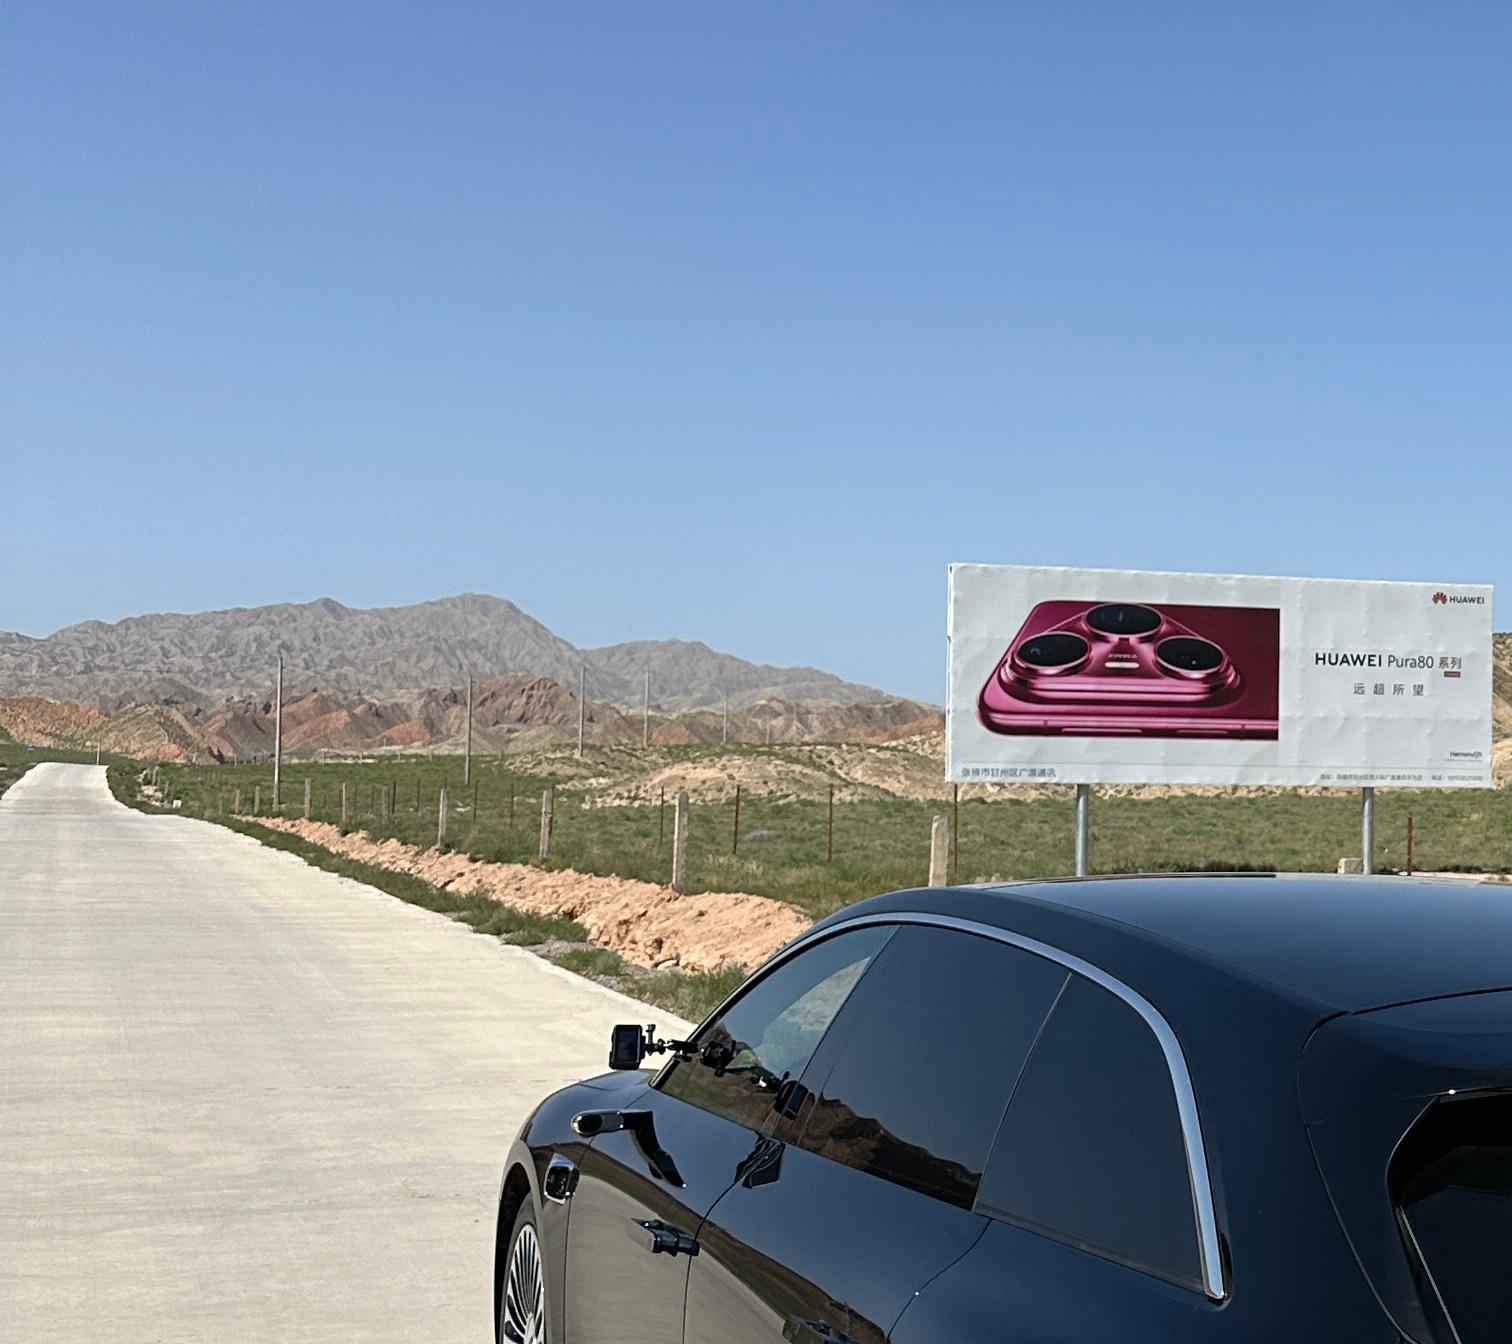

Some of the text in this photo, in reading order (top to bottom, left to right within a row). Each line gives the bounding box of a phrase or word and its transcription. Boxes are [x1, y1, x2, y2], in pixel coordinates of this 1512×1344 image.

[1449, 597, 1485, 605] HUAWEI
[1314, 652, 1462, 670] HUAWEI Pura80 系列
[1353, 682, 1424, 697] 远超所望
